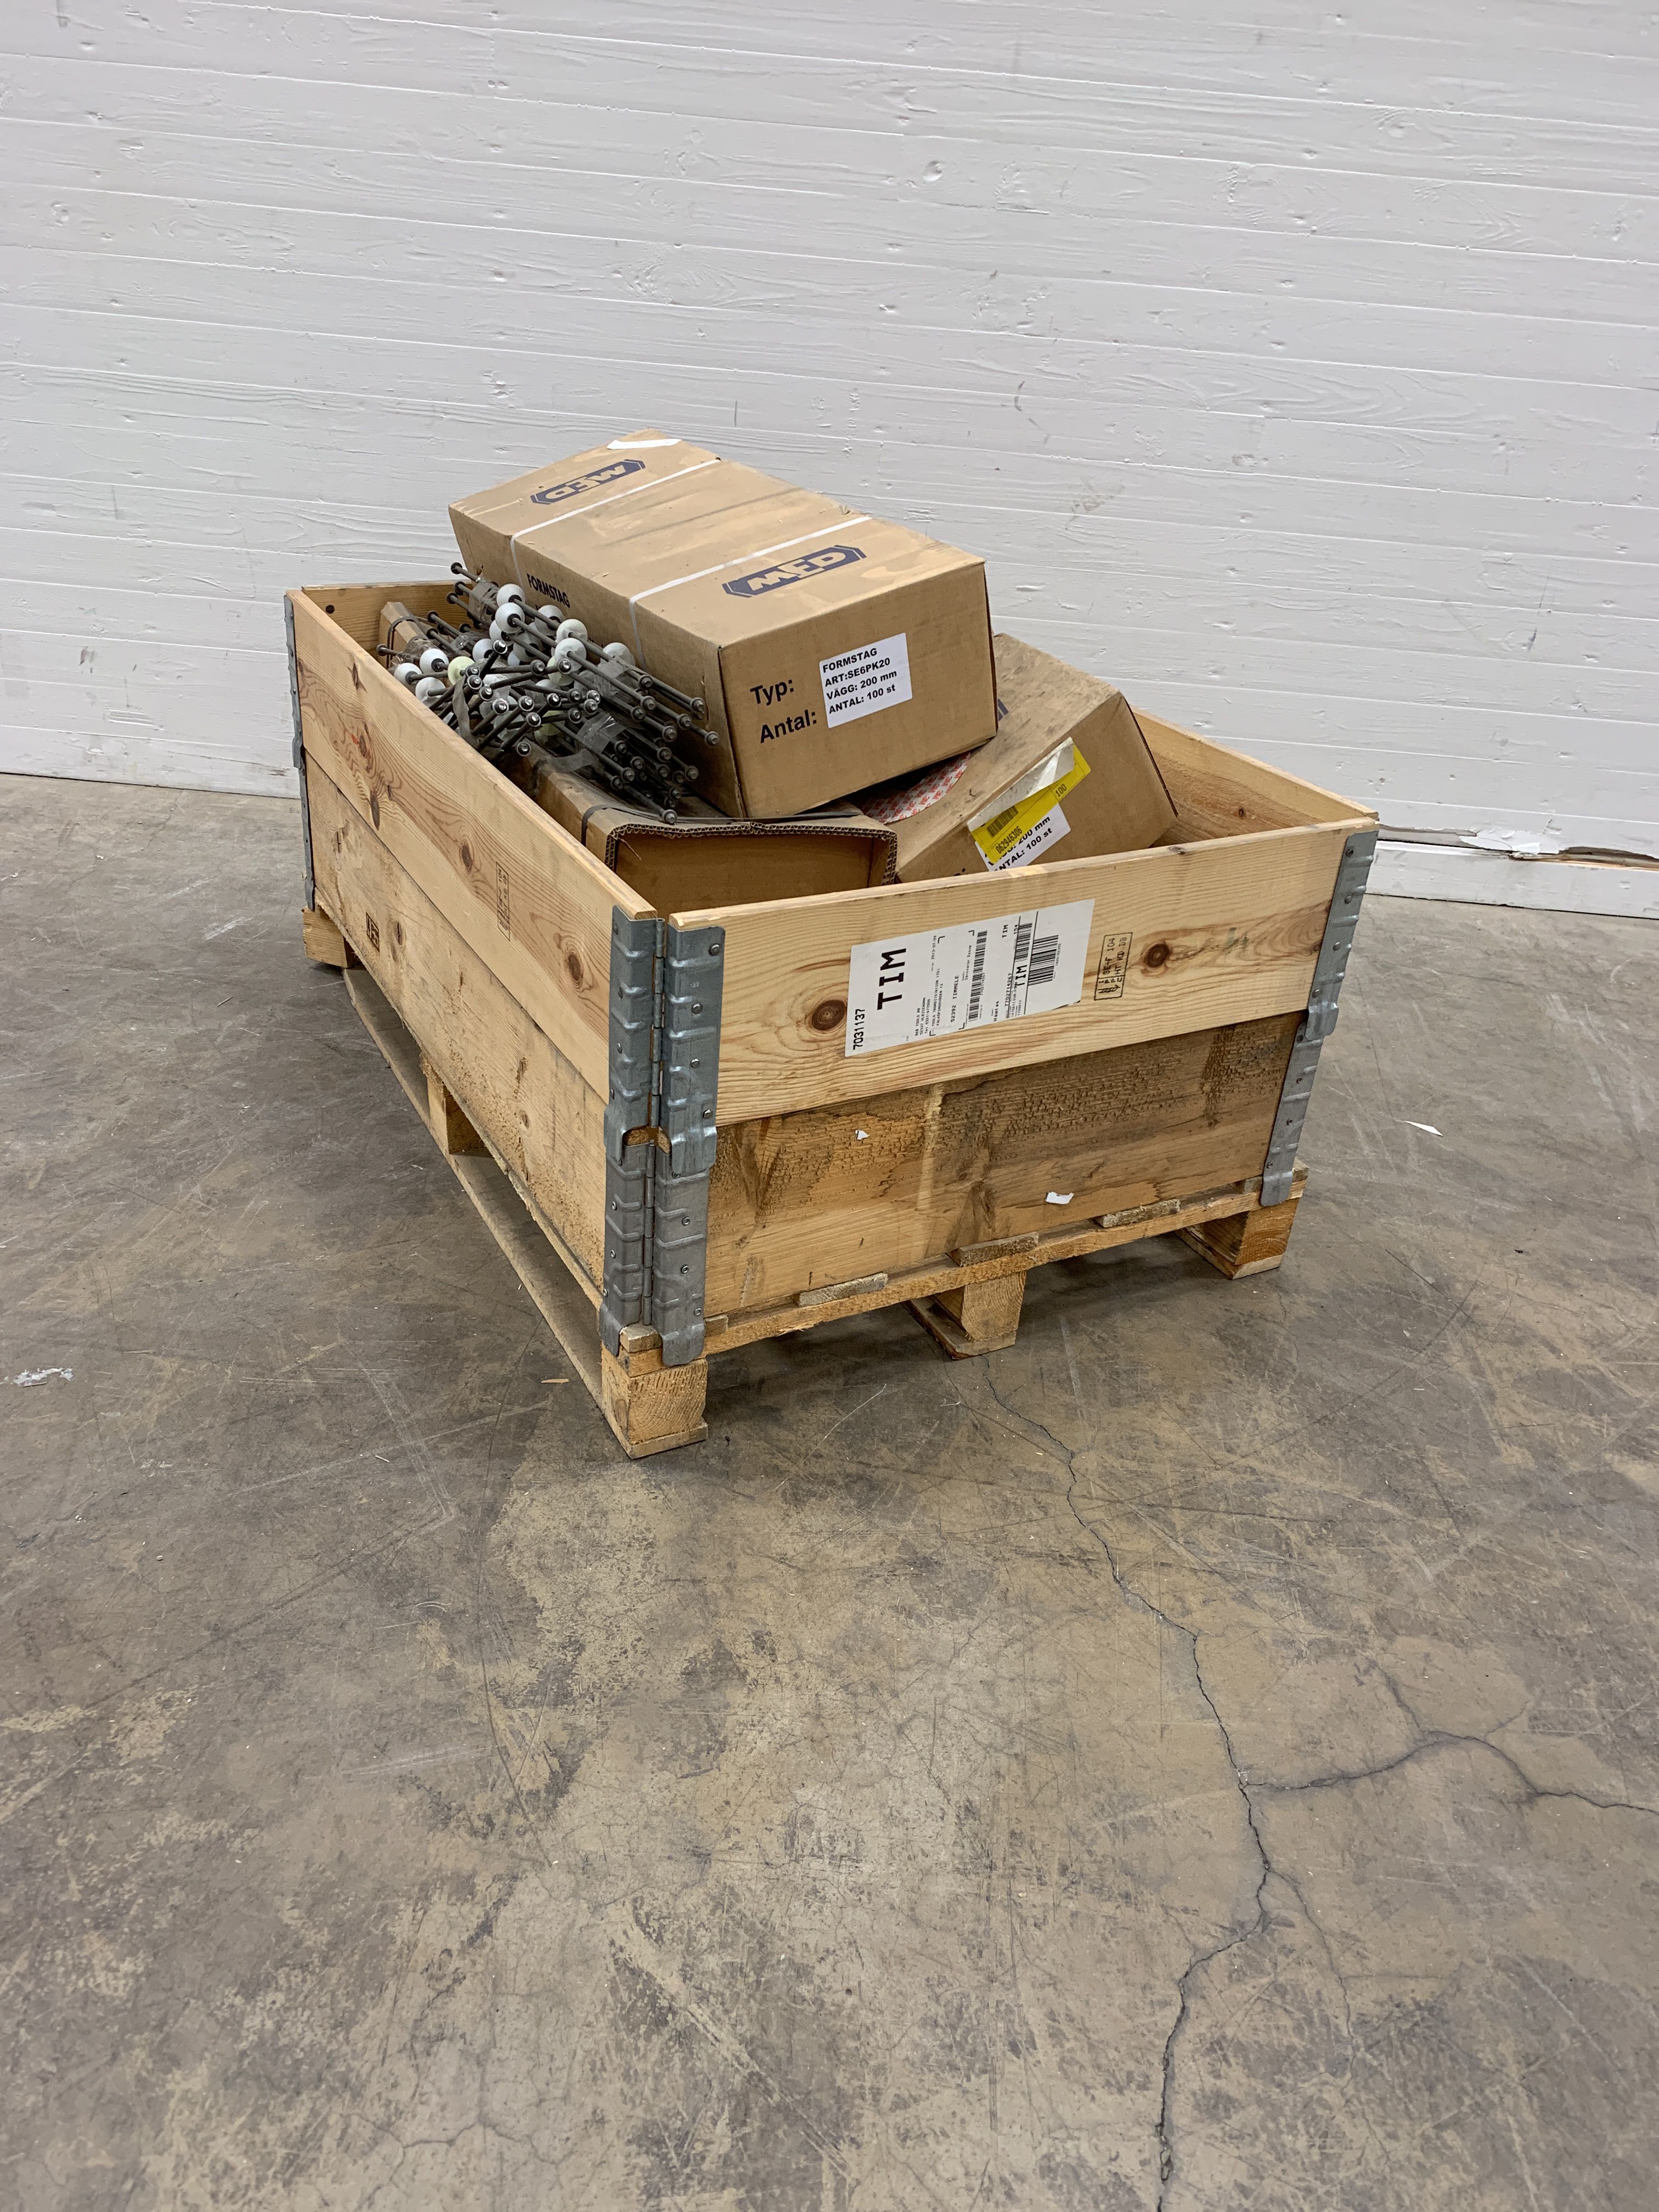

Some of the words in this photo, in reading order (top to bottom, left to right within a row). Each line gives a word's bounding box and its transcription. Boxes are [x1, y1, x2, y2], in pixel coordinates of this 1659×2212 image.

[545, 465, 626, 499] MED
[747, 552, 846, 591] MED
[527, 573, 571, 608] FORMSTAG
[822, 648, 877, 673] FORMSTAG
[825, 658, 890, 686] ART:SE6PK20
[750, 679, 794, 706] Typ:
[827, 685, 857, 699] VÄGG:
[860, 676, 877, 689] 200
[880, 670, 897, 682] mm
[829, 696, 864, 714] ANTAL:
[867, 688, 884, 700] 100
[887, 684, 896, 693] st
[760, 709, 817, 743] Antal:
[1056, 784, 1067, 797] 100
[996, 826, 1022, 854] 062946306
[1018, 829, 1032, 844] 200
[1035, 816, 1050, 831] mm
[995, 849, 1025, 871] NTAL:
[1026, 836, 1042, 850] 100
[1044, 827, 1052, 837] st
[1107, 938, 1115, 951] 104
[1119, 937, 1127, 946] DB
[1103, 957, 1113, 974] SE-F
[1114, 965, 1122, 974] HT
[1116, 951, 1125, 961] KD
[877, 947, 906, 1010] TIM
[1014, 964, 1027, 987] TIM
[1005, 973, 1013, 1007] 7702714267
[853, 1007, 866, 1050] 7031137
